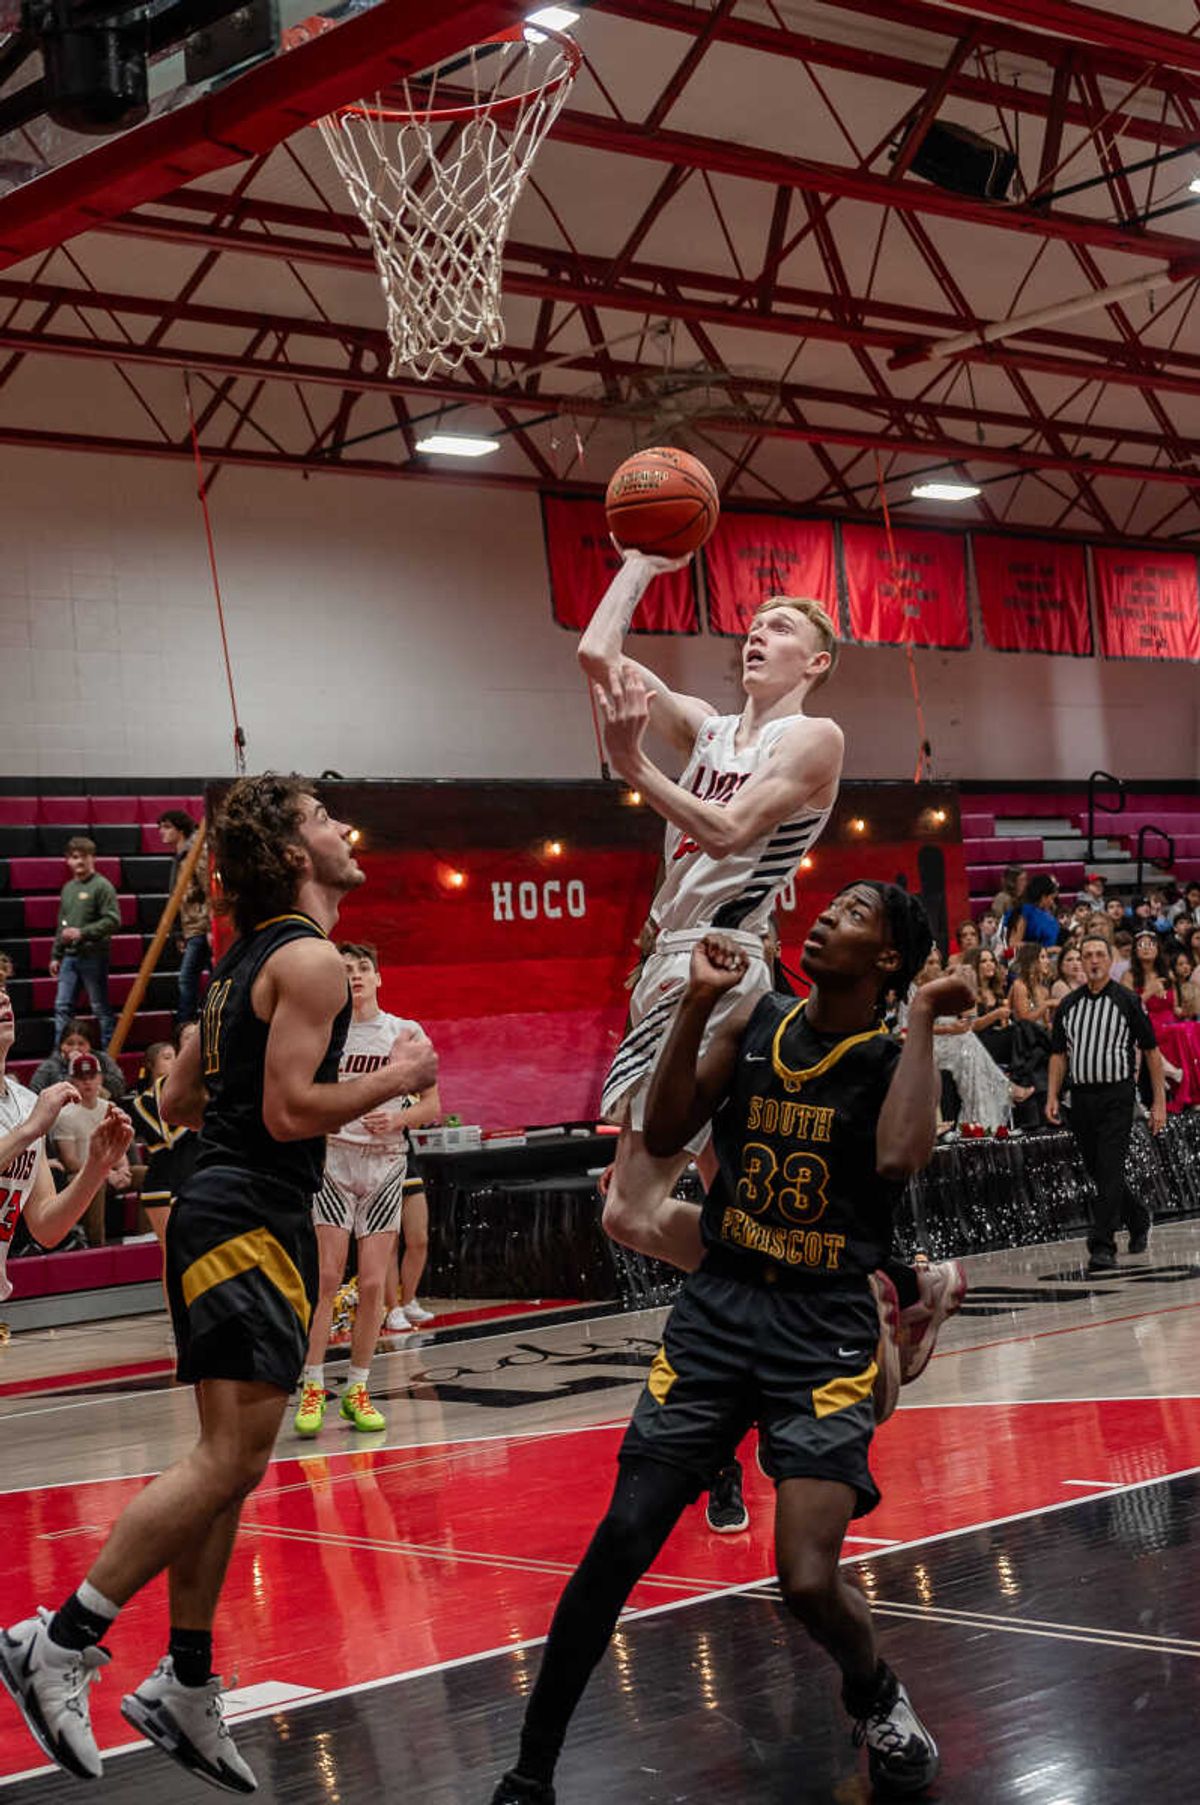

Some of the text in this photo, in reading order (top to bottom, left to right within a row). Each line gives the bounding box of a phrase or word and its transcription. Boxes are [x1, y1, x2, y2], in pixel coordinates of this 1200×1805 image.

[491, 880, 586, 921] HOCO
[339, 1054, 390, 1073] ION
[747, 1096, 836, 1143] SOUTH
[736, 1142, 830, 1224] 33
